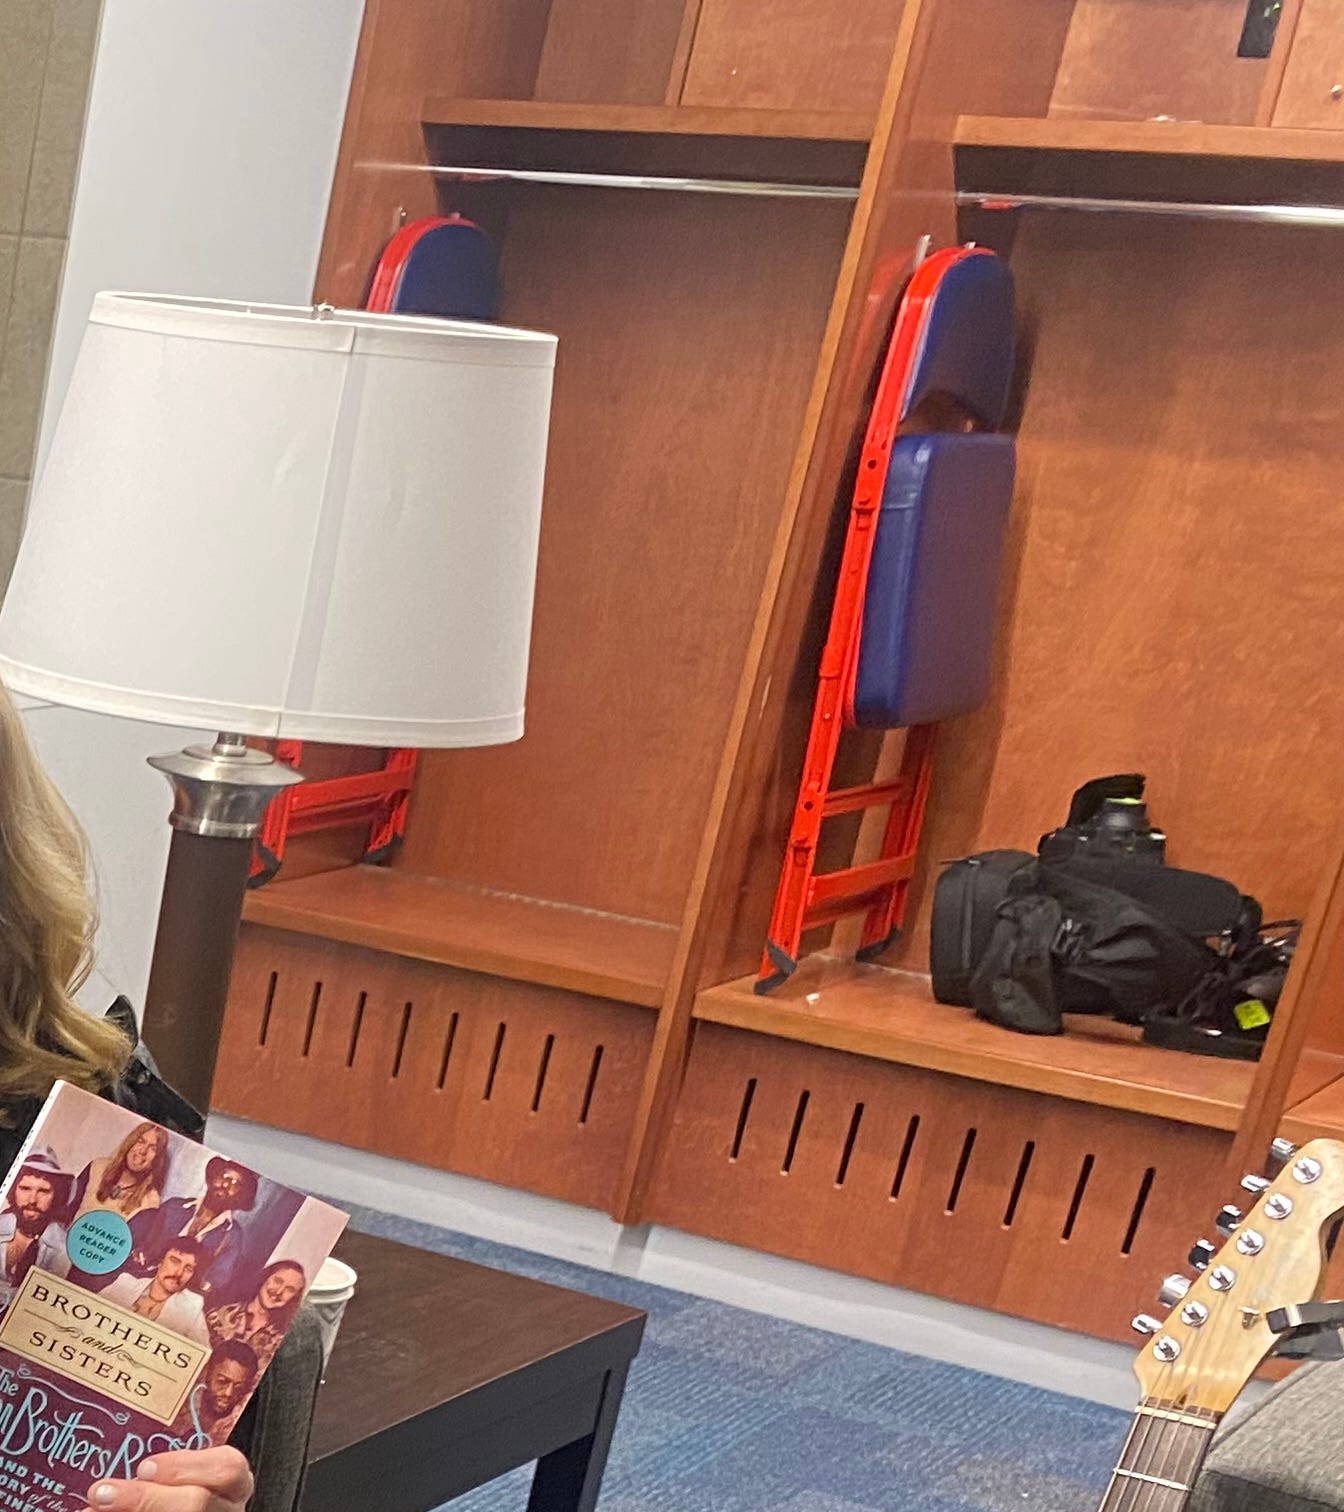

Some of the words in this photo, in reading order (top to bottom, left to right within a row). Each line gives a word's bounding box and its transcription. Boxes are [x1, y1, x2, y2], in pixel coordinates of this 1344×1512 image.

[78, 1234, 117, 1256] READER
[81, 1222, 127, 1247] ADVANCE
[79, 1248, 105, 1264] COPY
[30, 1283, 193, 1370] BROTHERS
[81, 1332, 119, 1355] and
[28, 1331, 153, 1398] SISTERS
[0, 1386, 112, 1479] Brothers
[32, 1472, 66, 1496] THE
[27, 1492, 48, 1506] of
